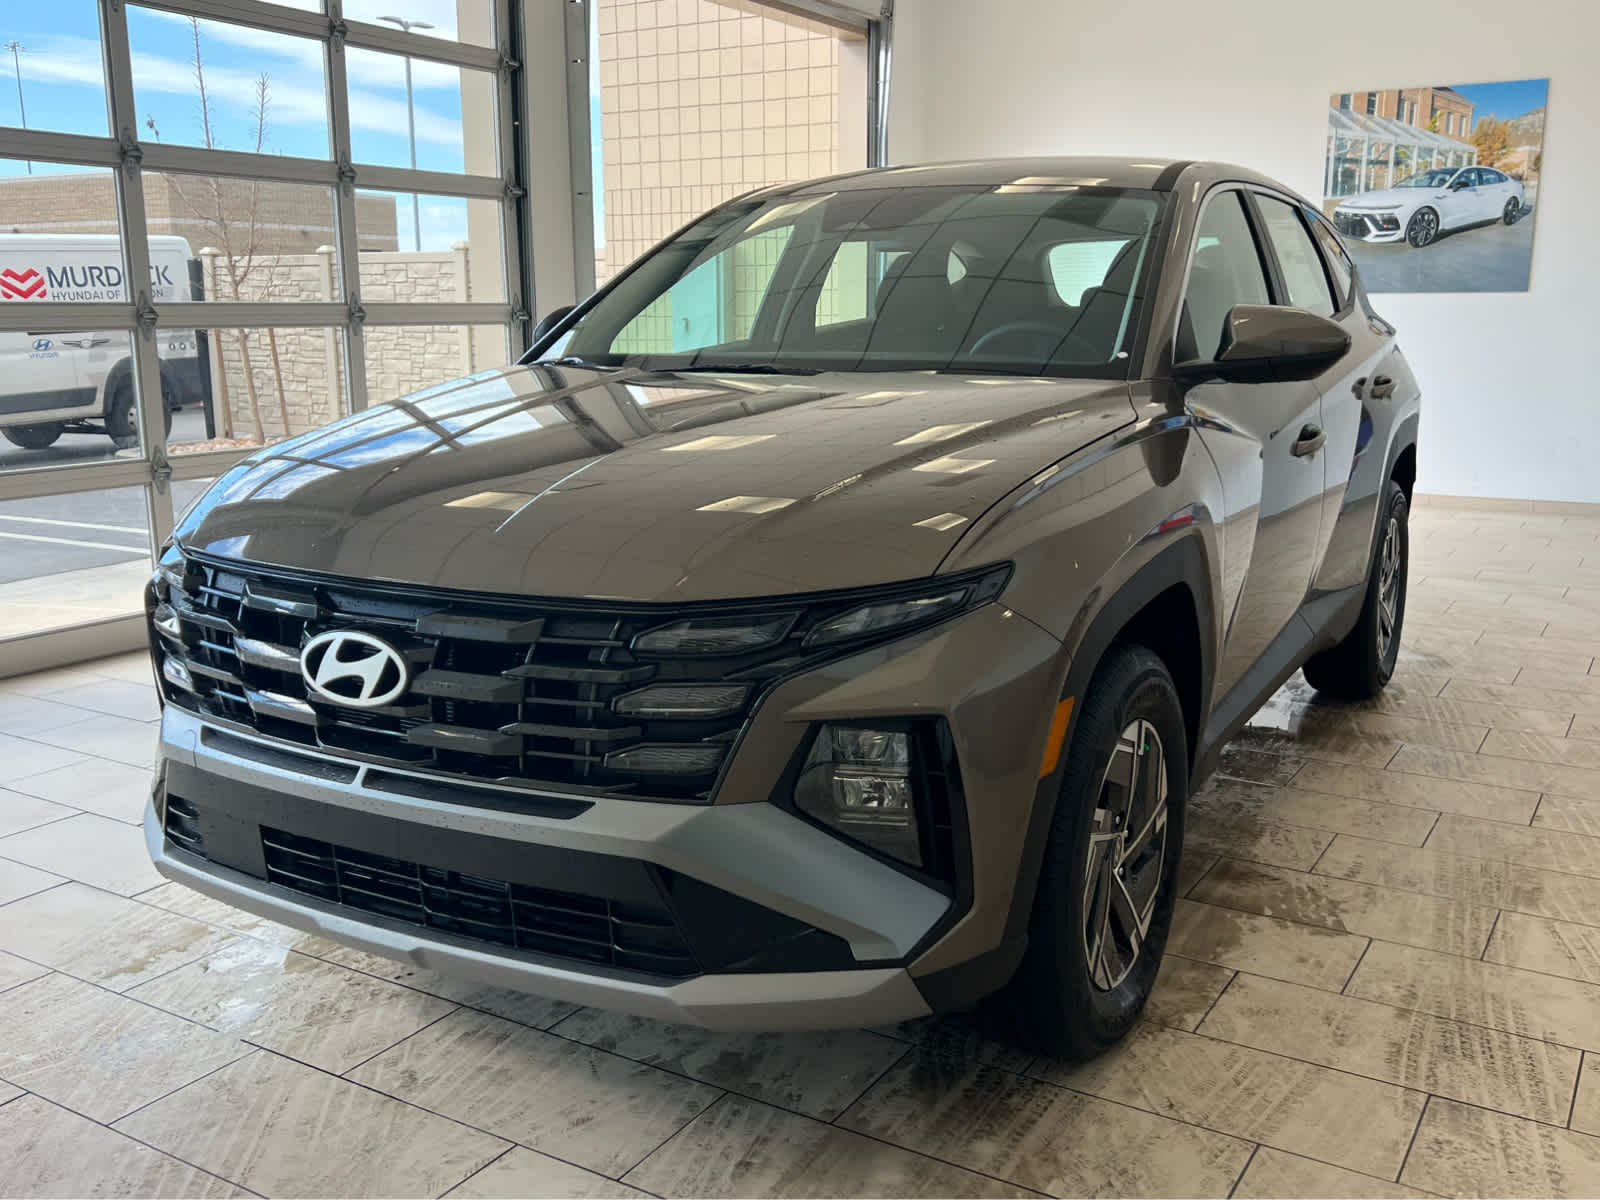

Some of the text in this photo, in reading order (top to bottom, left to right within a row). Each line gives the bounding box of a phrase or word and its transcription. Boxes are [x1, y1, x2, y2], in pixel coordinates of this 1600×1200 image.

[46, 265, 173, 288] MURDK
[52, 290, 121, 301] HYUNDAI OF
